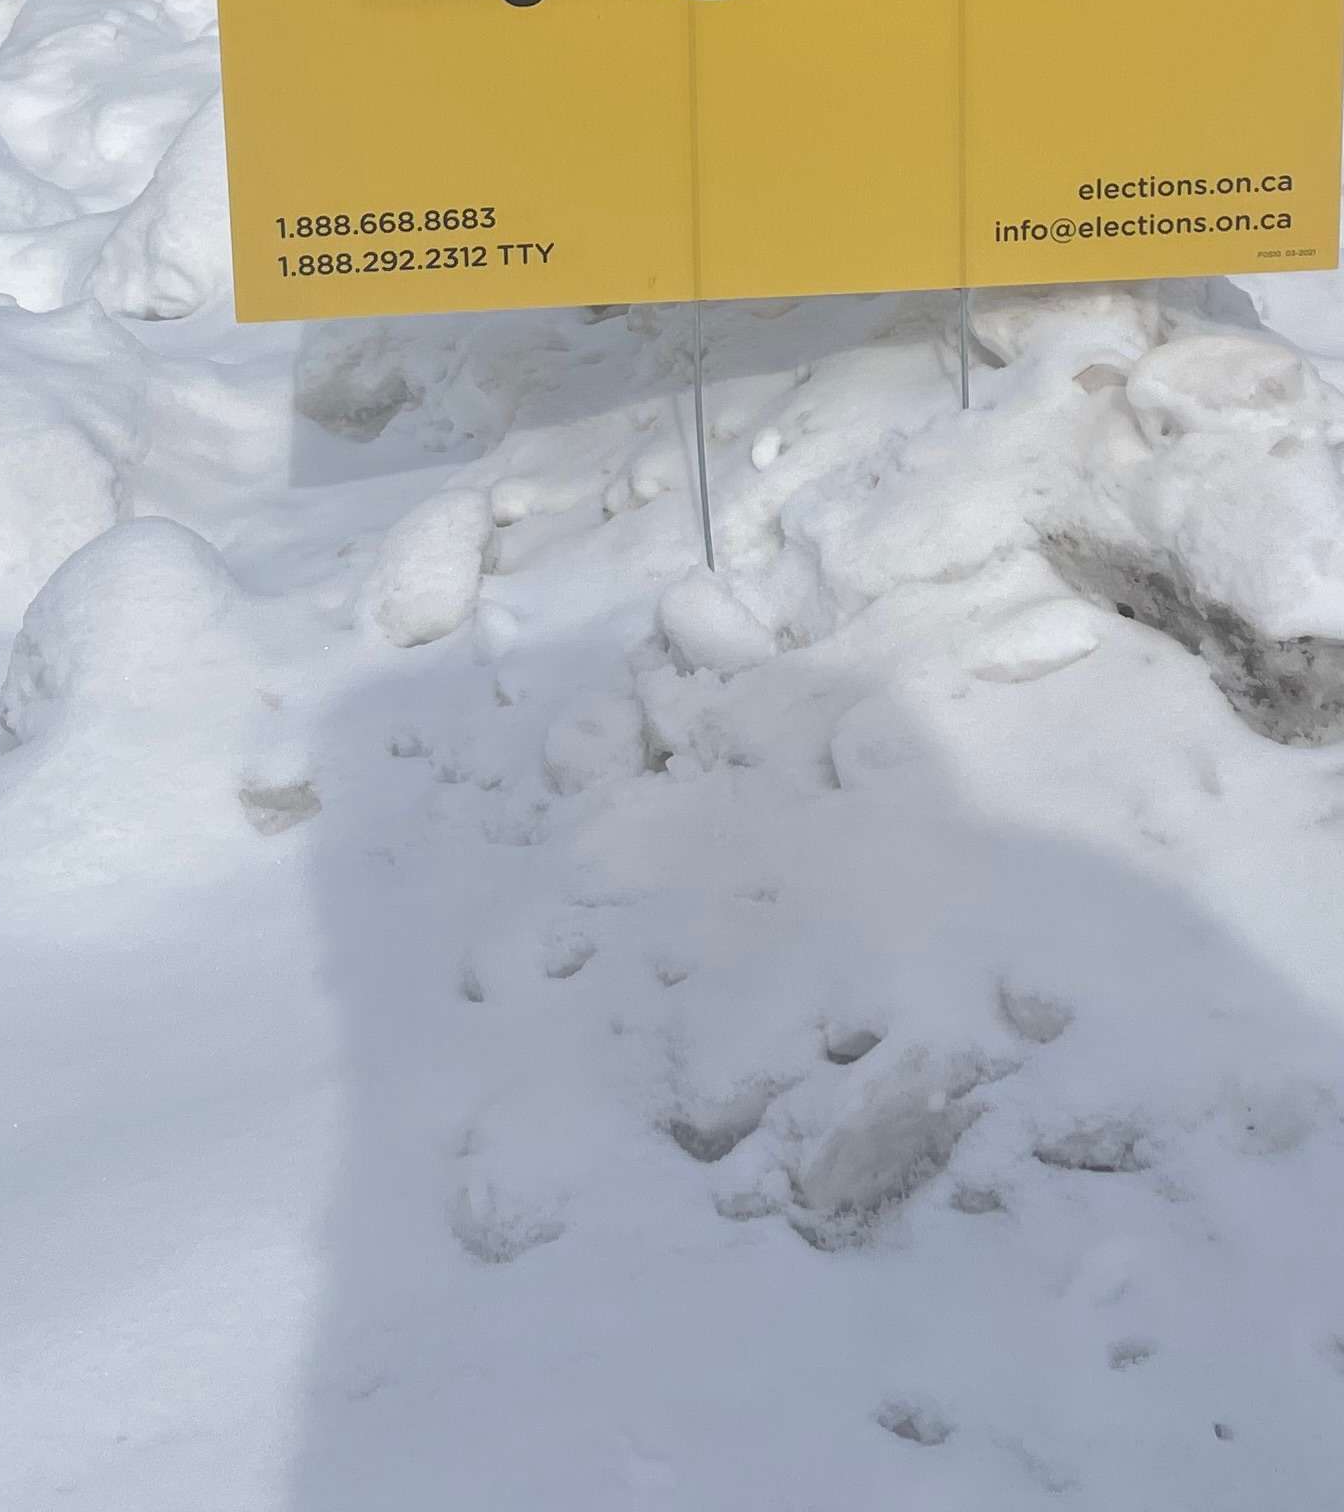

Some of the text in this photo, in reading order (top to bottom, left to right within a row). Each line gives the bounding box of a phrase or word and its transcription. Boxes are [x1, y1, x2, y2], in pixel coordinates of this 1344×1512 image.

[1078, 174, 1293, 201] elections.on.ca
[275, 207, 496, 239] 1.888.668.8683
[995, 211, 1292, 244] info@elections.on.ca
[278, 242, 555, 277] 1.888.292.2312 TTY
